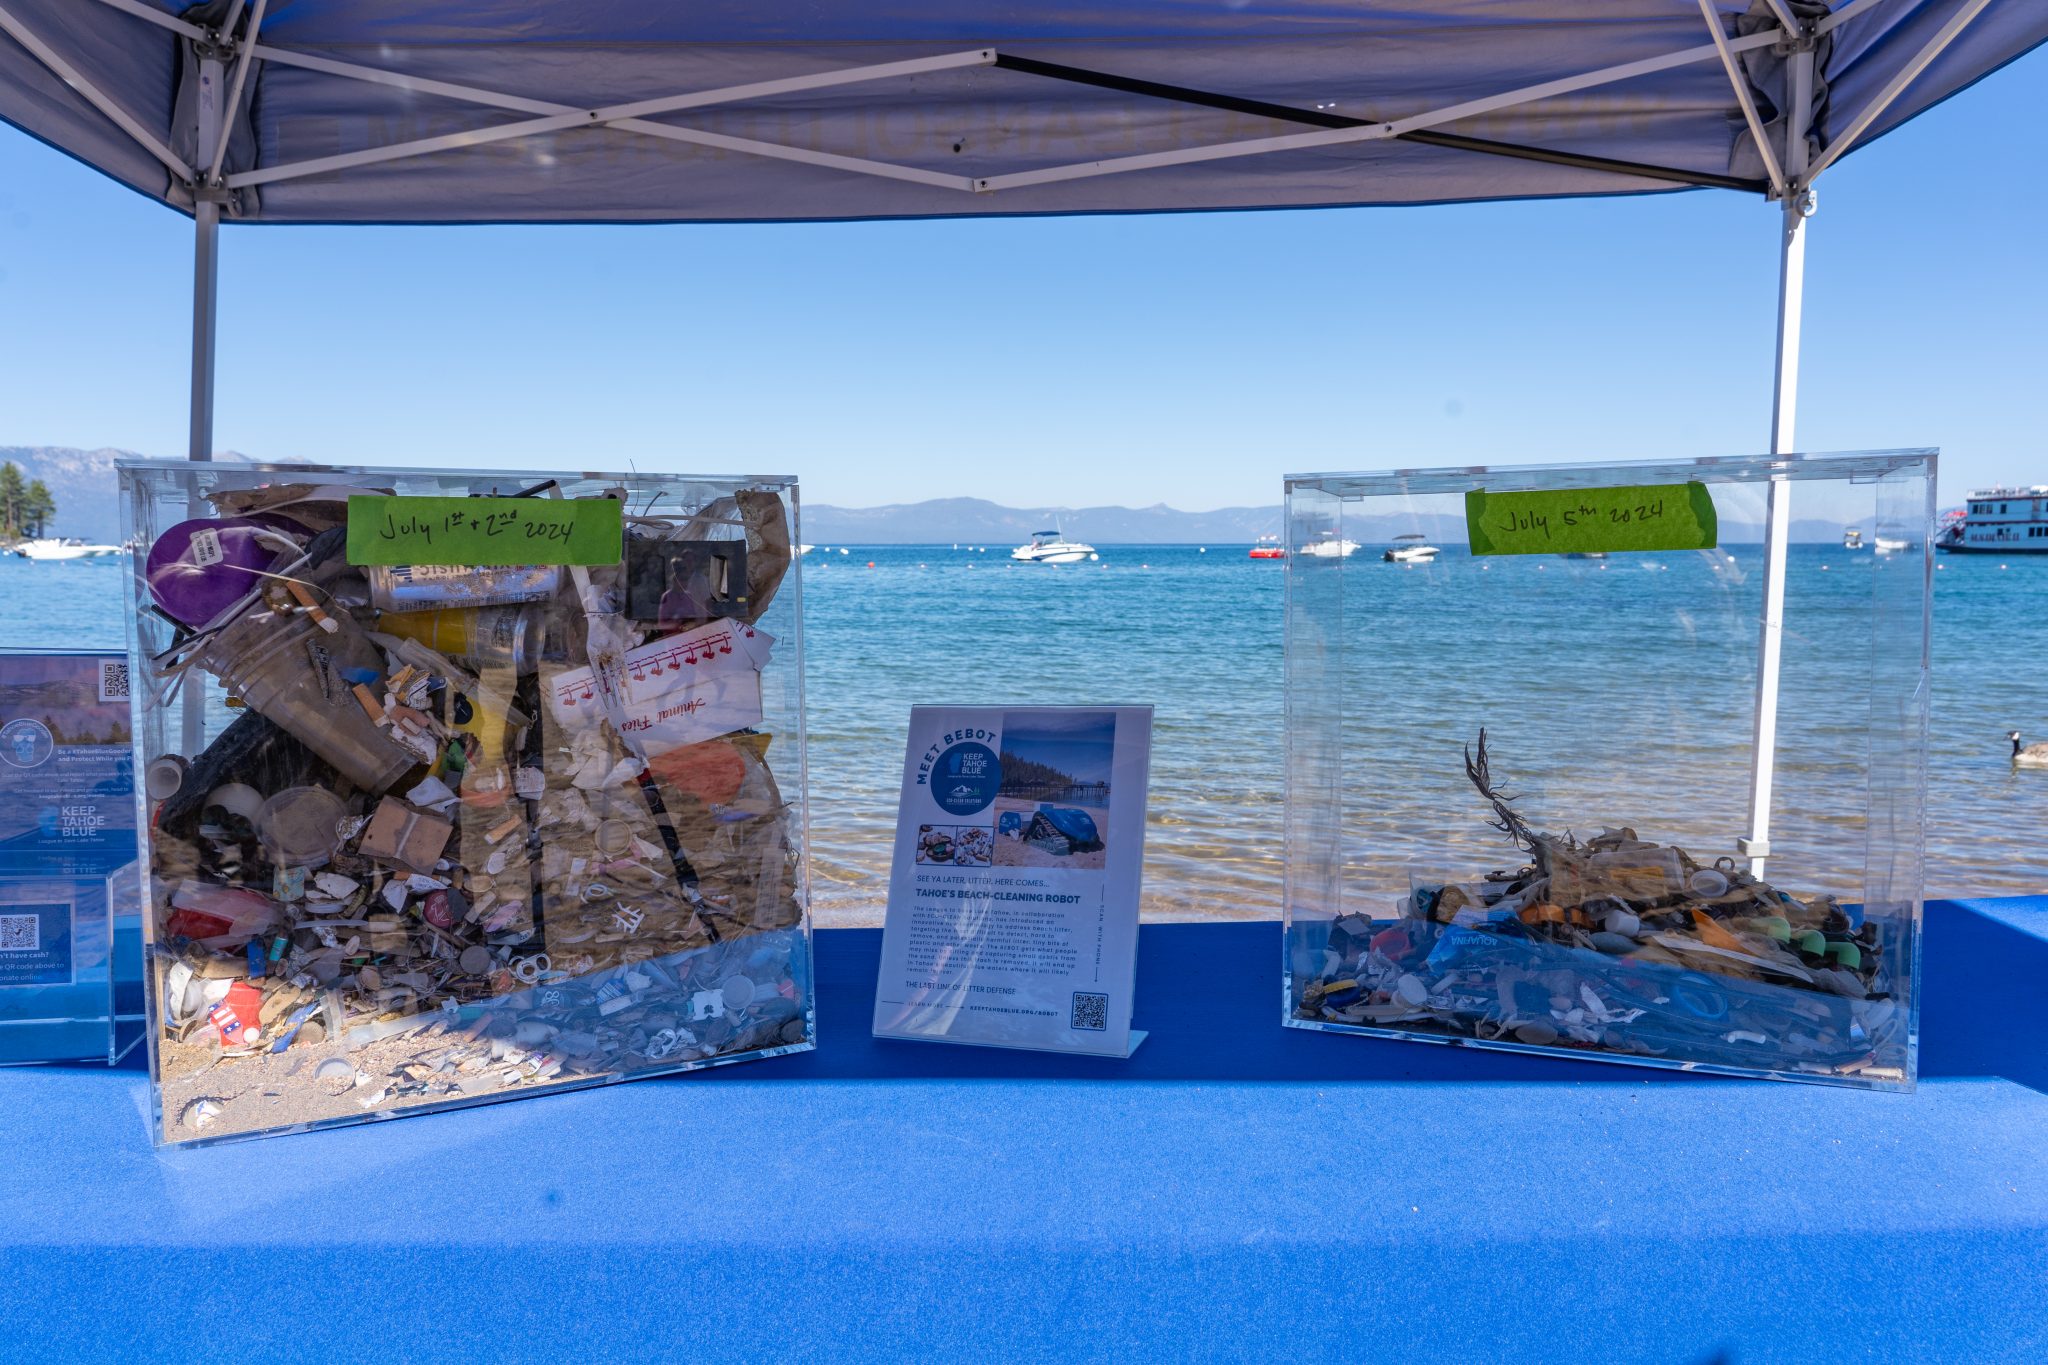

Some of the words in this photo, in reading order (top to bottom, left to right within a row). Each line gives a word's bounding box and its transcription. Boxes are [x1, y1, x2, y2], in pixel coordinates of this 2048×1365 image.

[380, 514, 431, 544] July
[486, 509, 518, 536] 2nd
[524, 521, 574, 544] 2024
[1499, 512, 1550, 539] July
[1610, 500, 1663, 523] 2024
[656, 698, 706, 724] Animal
[621, 716, 652, 732] Fries
[917, 744, 940, 784] MEET
[944, 728, 996, 745] BEBOT
[62, 806, 96, 816] KEEP
[61, 816, 105, 826] TAHOE
[63, 827, 97, 836] BLUE
[1016, 879, 1050, 887] COMES...
[916, 888, 955, 898] TAHOE'S
[957, 890, 1043, 902] BEACH-CLEANING
[1045, 894, 1081, 904] ROBOT
[1451, 936, 1498, 946] AQUAFINA
